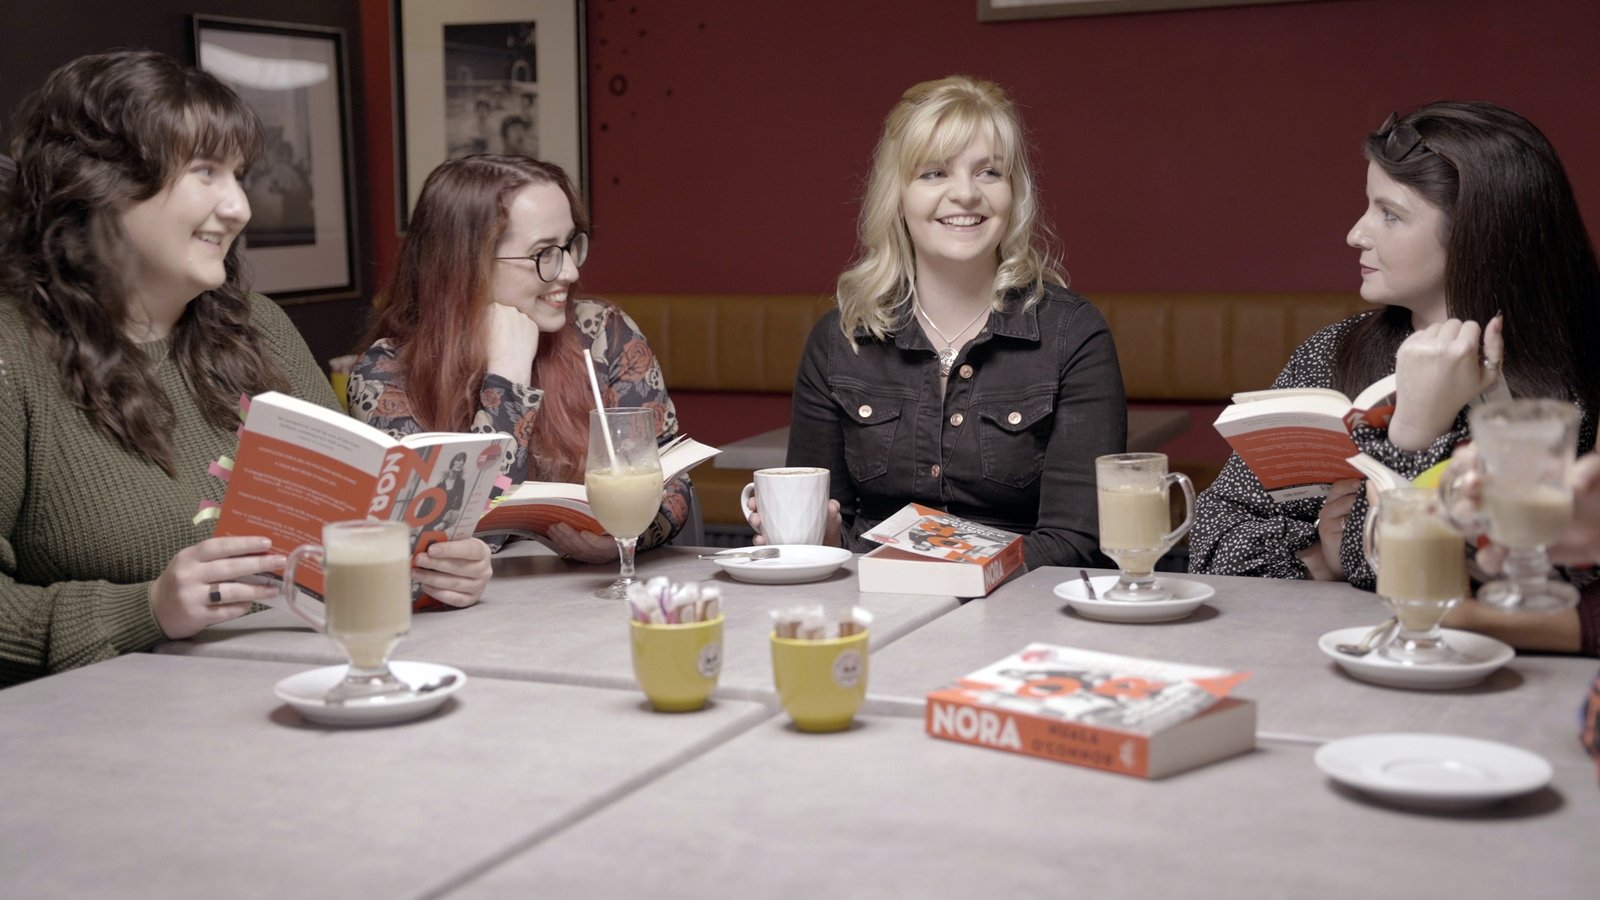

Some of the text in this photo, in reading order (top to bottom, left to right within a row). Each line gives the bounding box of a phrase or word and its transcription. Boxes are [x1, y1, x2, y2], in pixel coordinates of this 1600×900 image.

[366, 452, 405, 524] NOR
[984, 558, 1005, 591] NORA
[932, 702, 1022, 750] NORA
